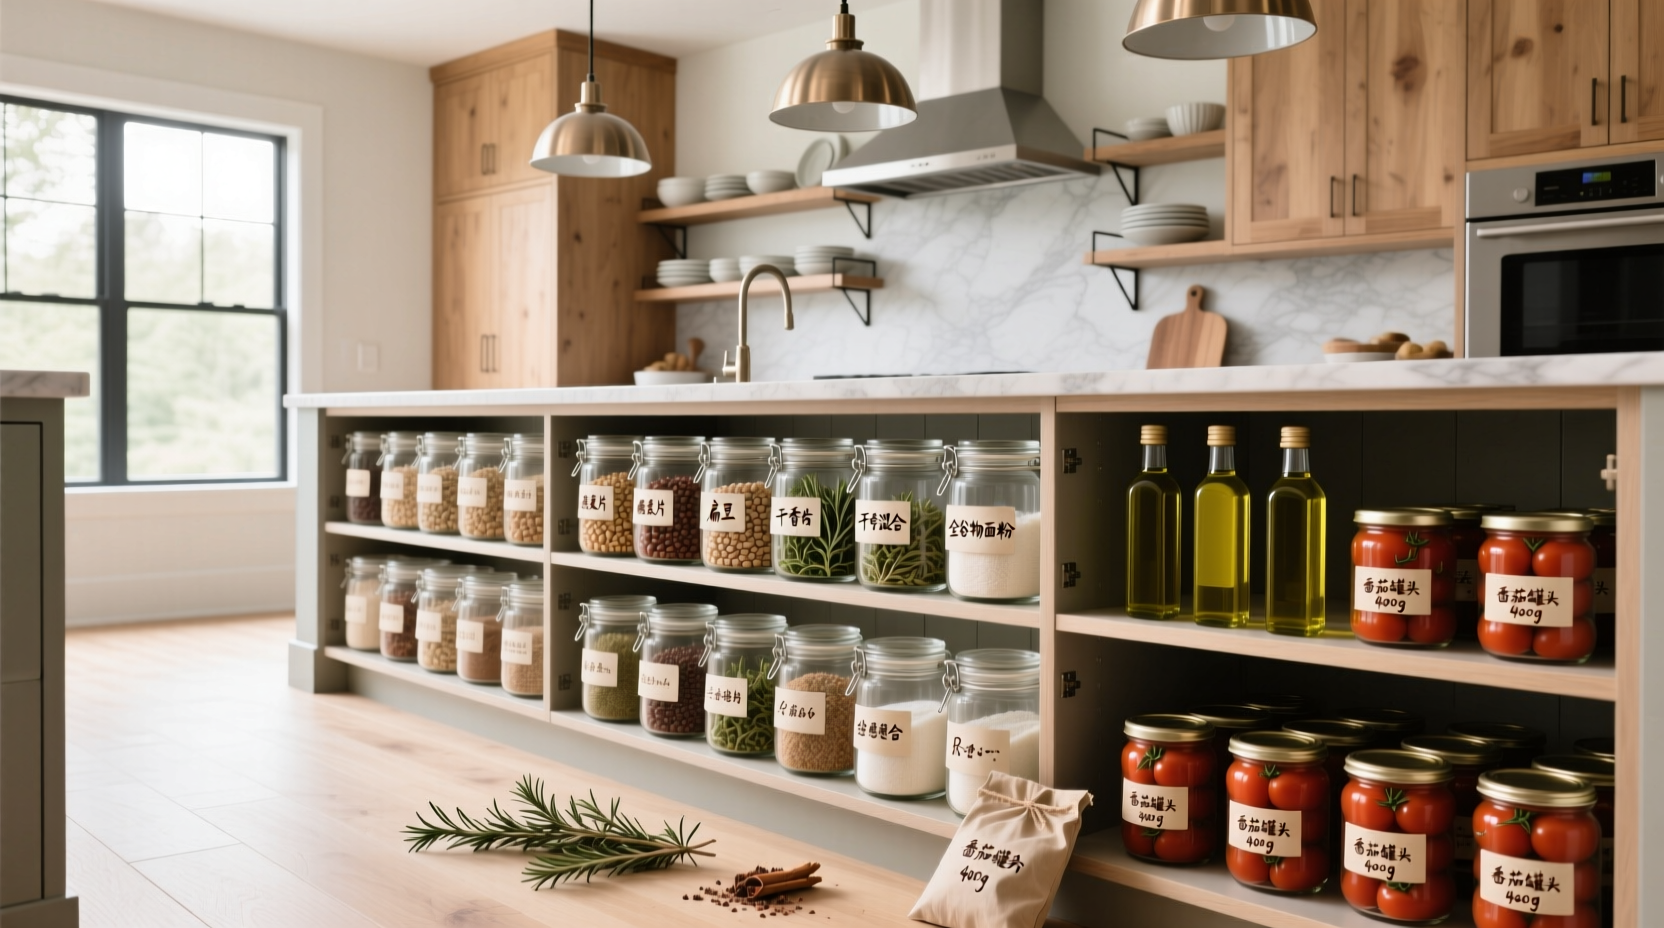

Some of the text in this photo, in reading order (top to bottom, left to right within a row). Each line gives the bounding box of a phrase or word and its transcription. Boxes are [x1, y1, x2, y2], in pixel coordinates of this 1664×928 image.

[706, 499, 736, 522] 扁豆
[1363, 577, 1420, 596] 番茄罐头
[1497, 586, 1560, 607] 番茄罐头
[1374, 596, 1407, 614] 400g
[1509, 605, 1543, 624] 400g
[1129, 791, 1177, 812] 番茄罐头
[1237, 814, 1291, 838] 番茄罐头
[1246, 835, 1275, 855] 400g
[1353, 837, 1412, 863] 番茄罐头
[959, 865, 990, 893] 400g
[1364, 859, 1396, 881] 400g
[1491, 865, 1561, 893] 番茄罐头
[1505, 890, 1541, 912] 400g
